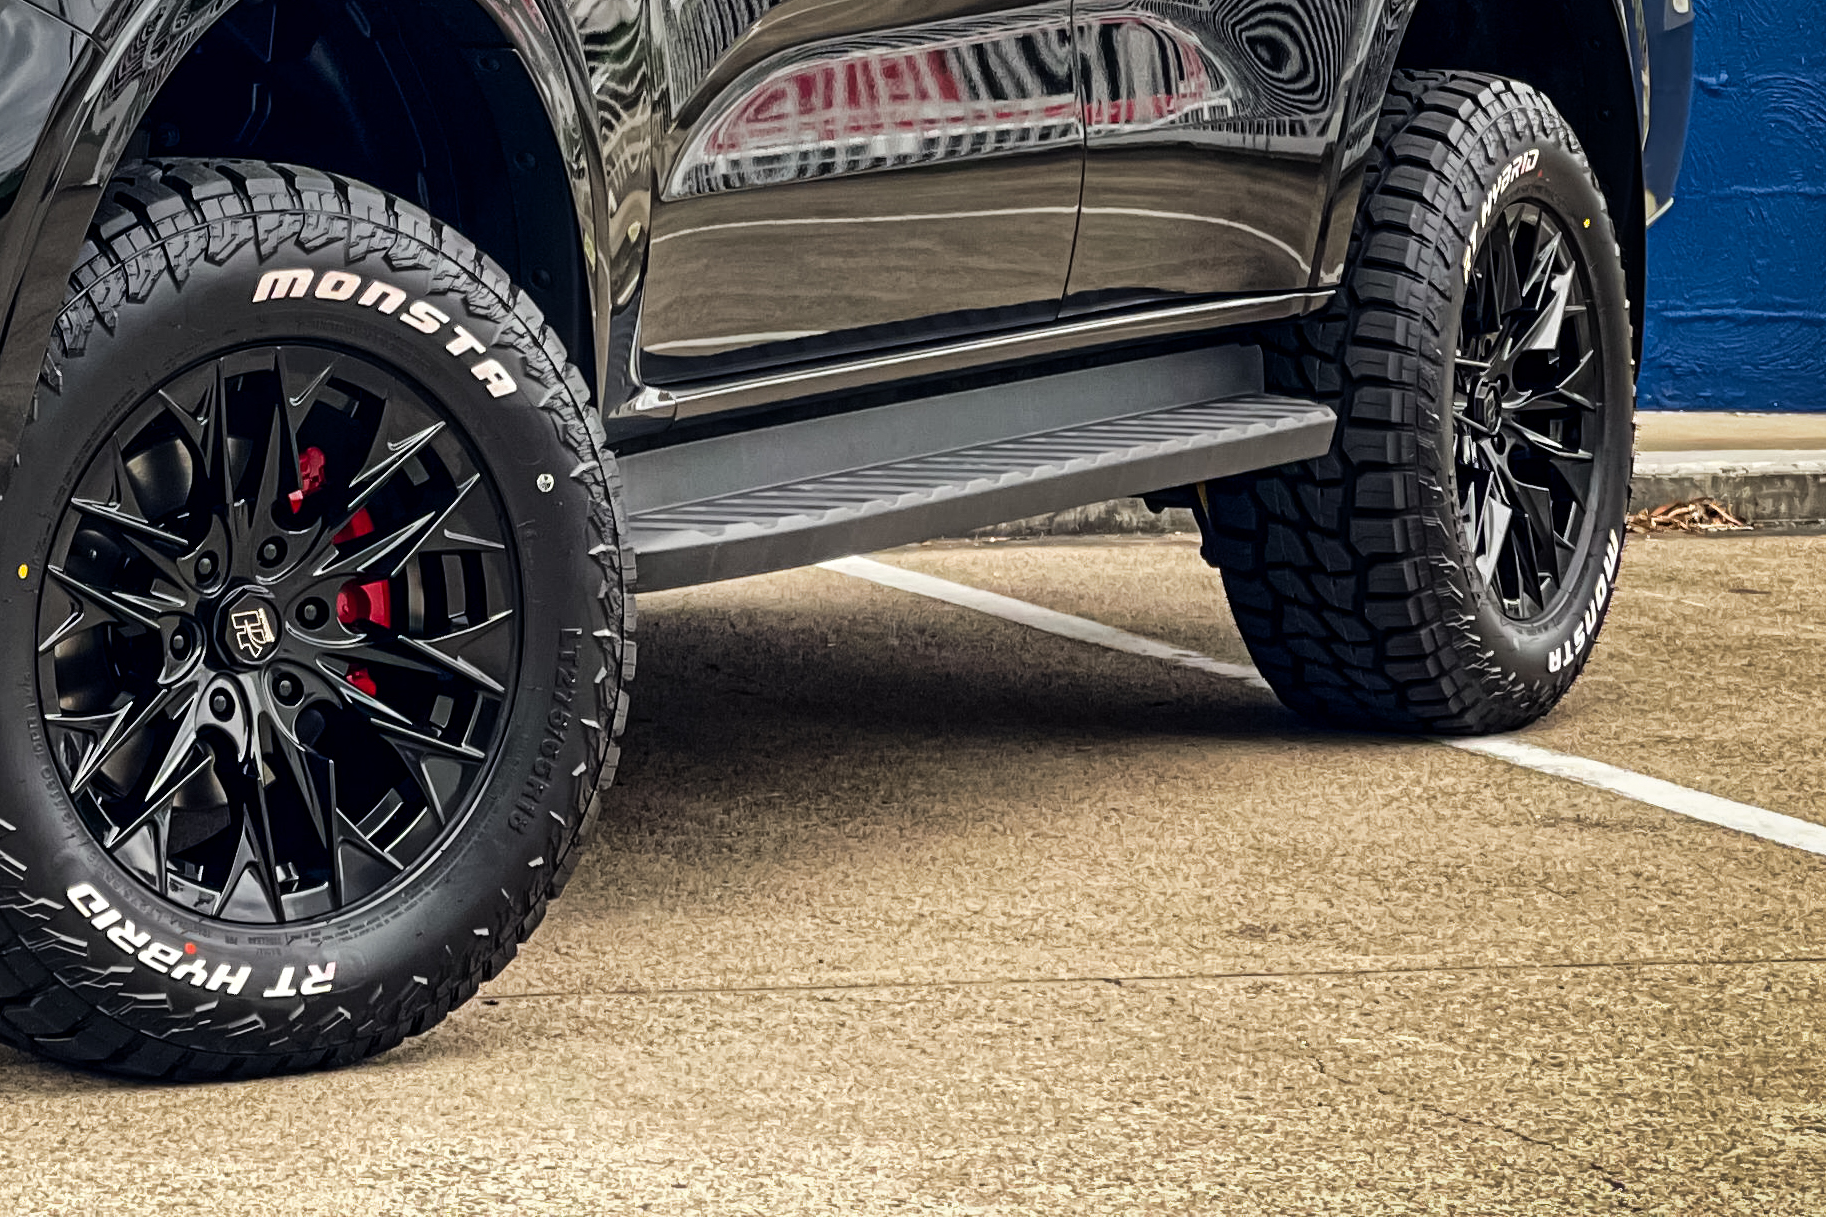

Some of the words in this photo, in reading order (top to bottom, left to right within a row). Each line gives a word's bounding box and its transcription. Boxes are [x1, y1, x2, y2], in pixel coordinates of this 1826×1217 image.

[1480, 148, 1540, 228] HYBRID
[251, 267, 518, 399] MONSTA
[66, 882, 253, 996] HYBRID
[262, 961, 337, 998] RT
